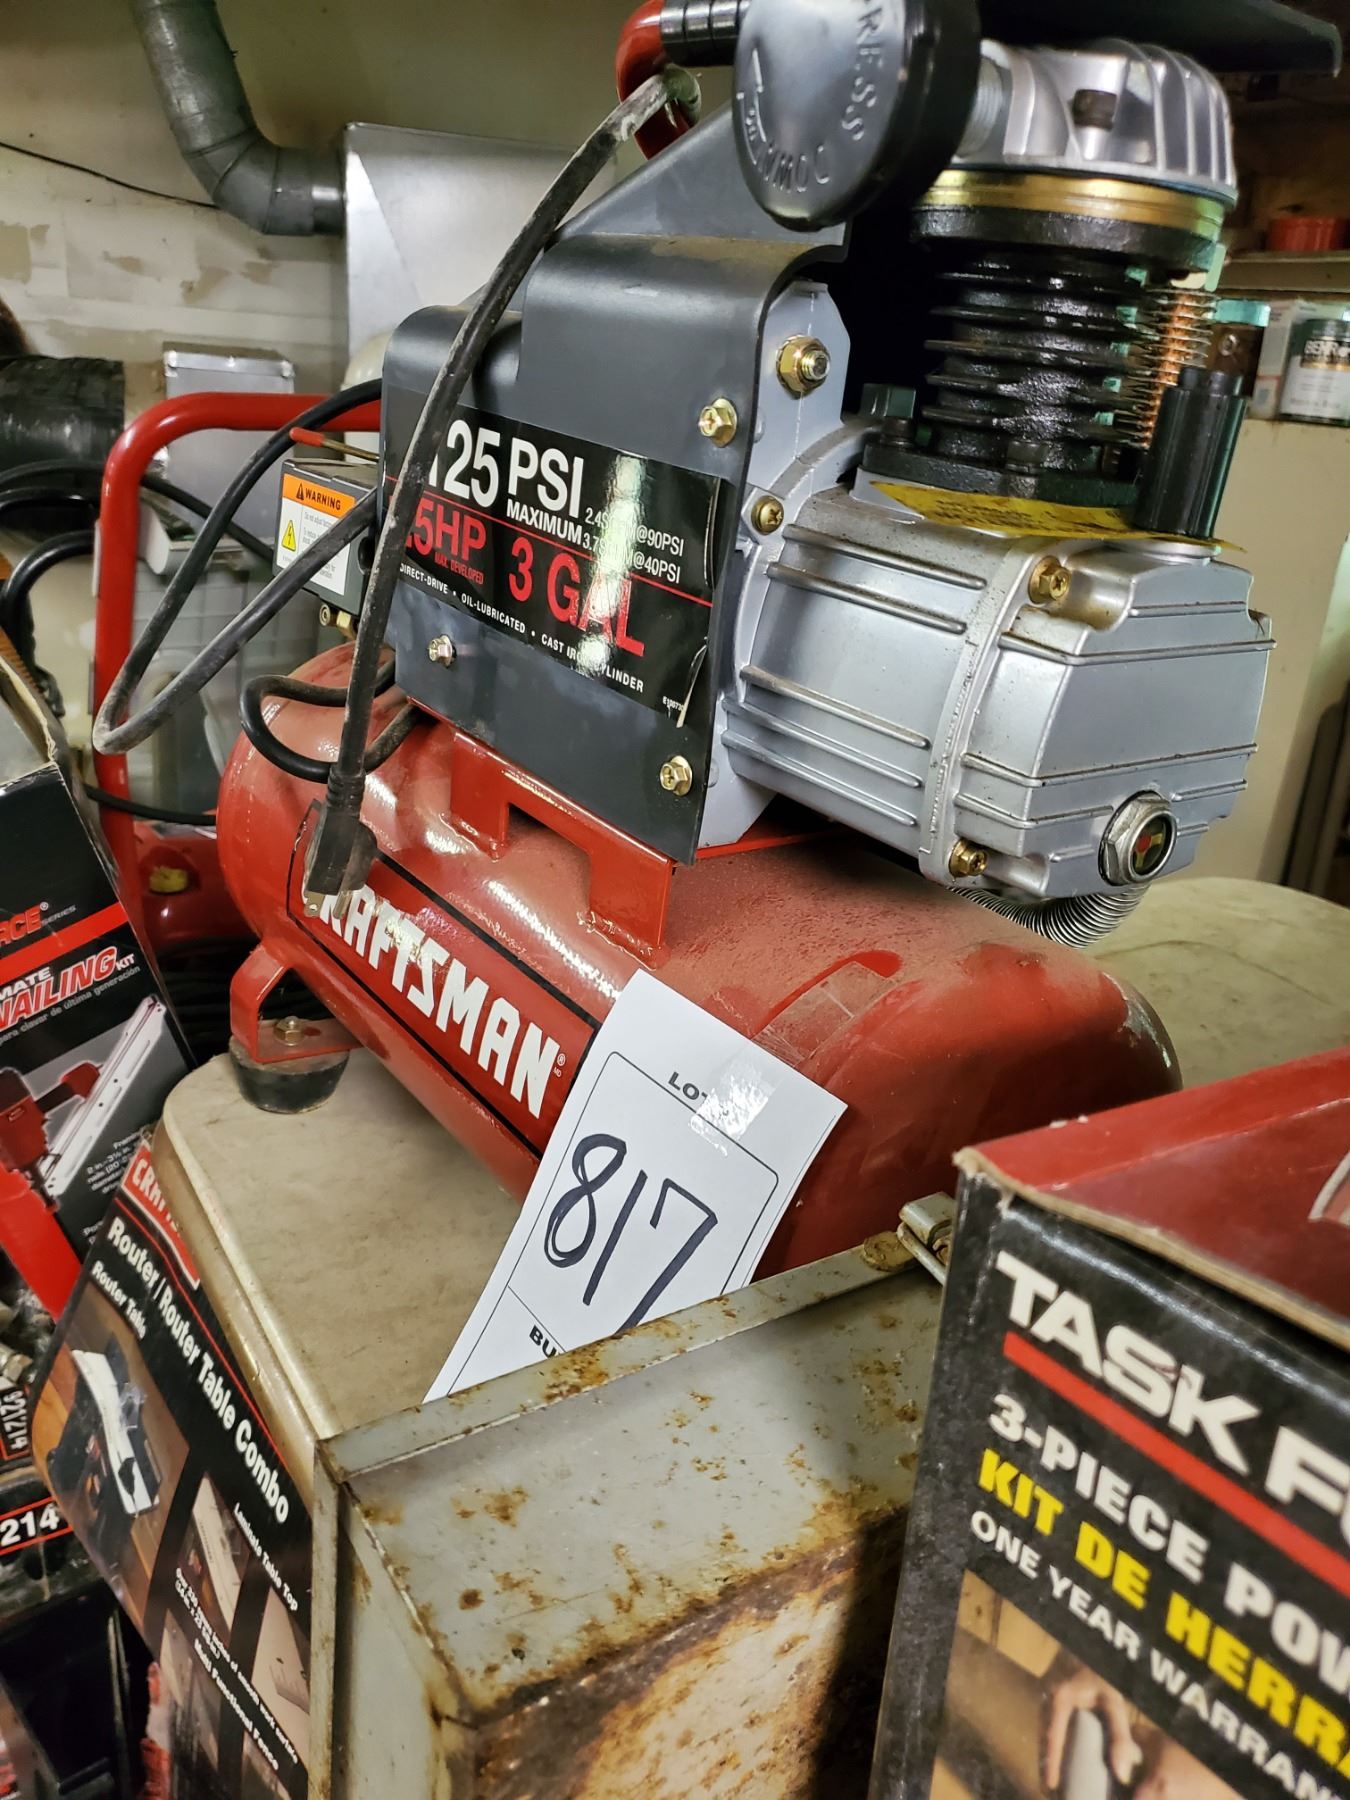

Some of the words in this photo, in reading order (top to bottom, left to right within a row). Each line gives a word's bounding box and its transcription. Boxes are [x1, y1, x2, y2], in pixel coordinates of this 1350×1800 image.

[305, 487, 341, 511] WARNING
[507, 436, 584, 519] PSI
[506, 498, 582, 545] MAXIMUM
[582, 532, 681, 585] 3.7SM@40PSI
[584, 506, 685, 558] 2.4SM@90PSI
[402, 496, 487, 561] .5HP
[508, 536, 534, 602] 3
[546, 552, 645, 657] GAL
[449, 559, 485, 585] DEVELOPED
[461, 592, 526, 634] OIL-LUBRICATED
[541, 633, 564, 655] CAST
[566, 645, 587, 664] IRO
[599, 662, 644, 693] YLINDER
[20, 1013, 49, 1033] clavar
[50, 1005, 62, 1018] de
[63, 990, 93, 1011] última
[94, 965, 141, 996] generación
[116, 953, 136, 972] KIT
[304, 880, 561, 1120] AFTSMAN
[668, 1071, 710, 1103] LO
[544, 1133, 719, 1334] 817
[92, 1260, 128, 1309] Router
[122, 1298, 148, 1340] Table
[107, 1216, 159, 1291] Router
[159, 1285, 201, 1366] Router
[198, 1351, 236, 1431] Table
[234, 1418, 289, 1525] Combo
[529, 1324, 561, 1359] BU
[996, 1249, 1261, 1476] TASK
[1264, 1425, 1350, 1548] F
[0, 1503, 60, 1547] 214
[988, 1393, 1211, 1585] 3-PIECE
[233, 1502, 263, 1557] Laminate
[262, 1551, 282, 1589] Table
[283, 1582, 298, 1611] Top
[970, 1509, 1038, 1580] ONE
[1049, 1564, 1142, 1662] YEAR
[1150, 1646, 1343, 1800] WARRAN
[978, 1448, 1064, 1537] KIT
[1074, 1520, 1151, 1611] DE
[1165, 1589, 1350, 1780] HERR
[194, 1638, 212, 1673] Multi
[211, 1667, 253, 1732] Functional
[253, 1727, 279, 1771] Fence
[275, 1726, 298, 1765] surface
